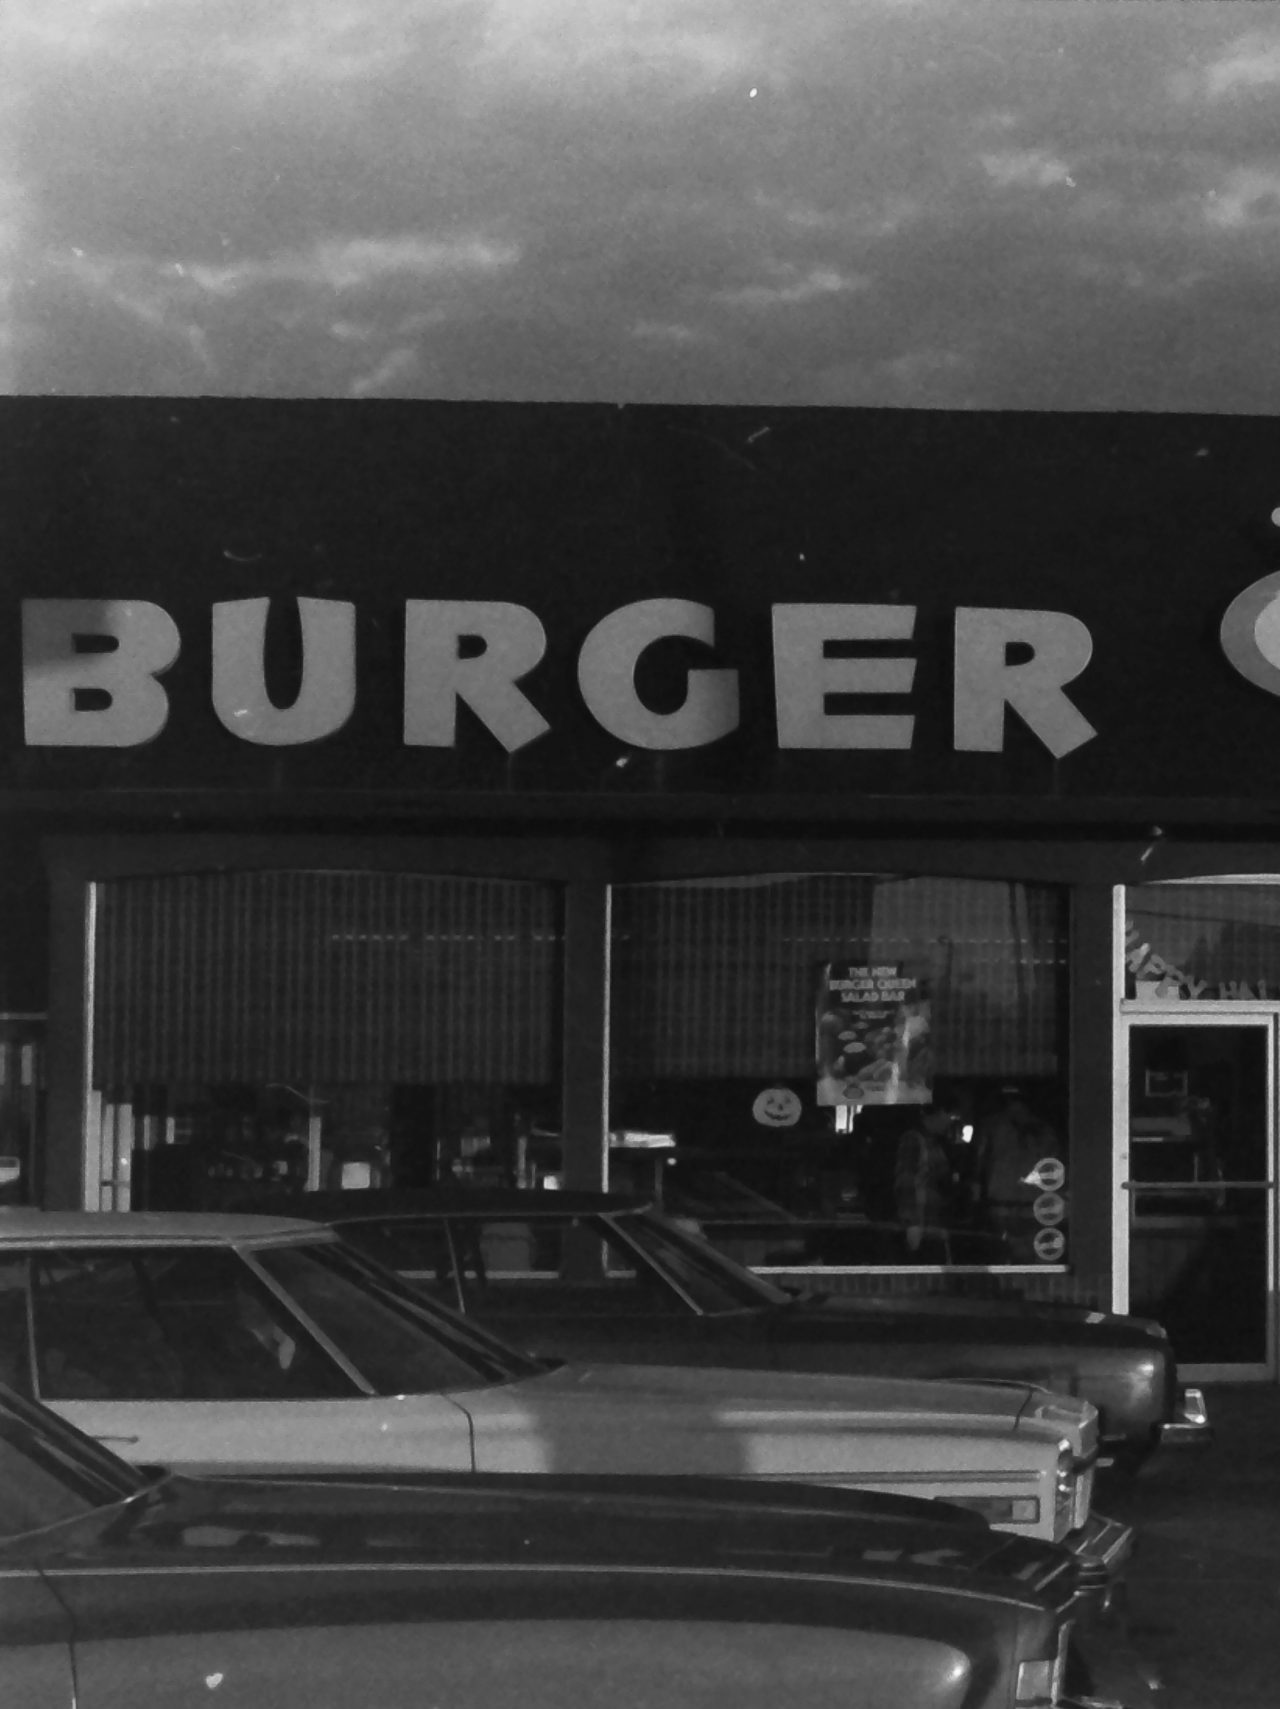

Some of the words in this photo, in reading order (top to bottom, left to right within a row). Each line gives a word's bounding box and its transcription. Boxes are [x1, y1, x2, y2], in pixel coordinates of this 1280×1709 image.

[21, 596, 1097, 759] BURGER
[841, 991, 879, 1002] SALAD
[881, 990, 905, 1002] BAR
